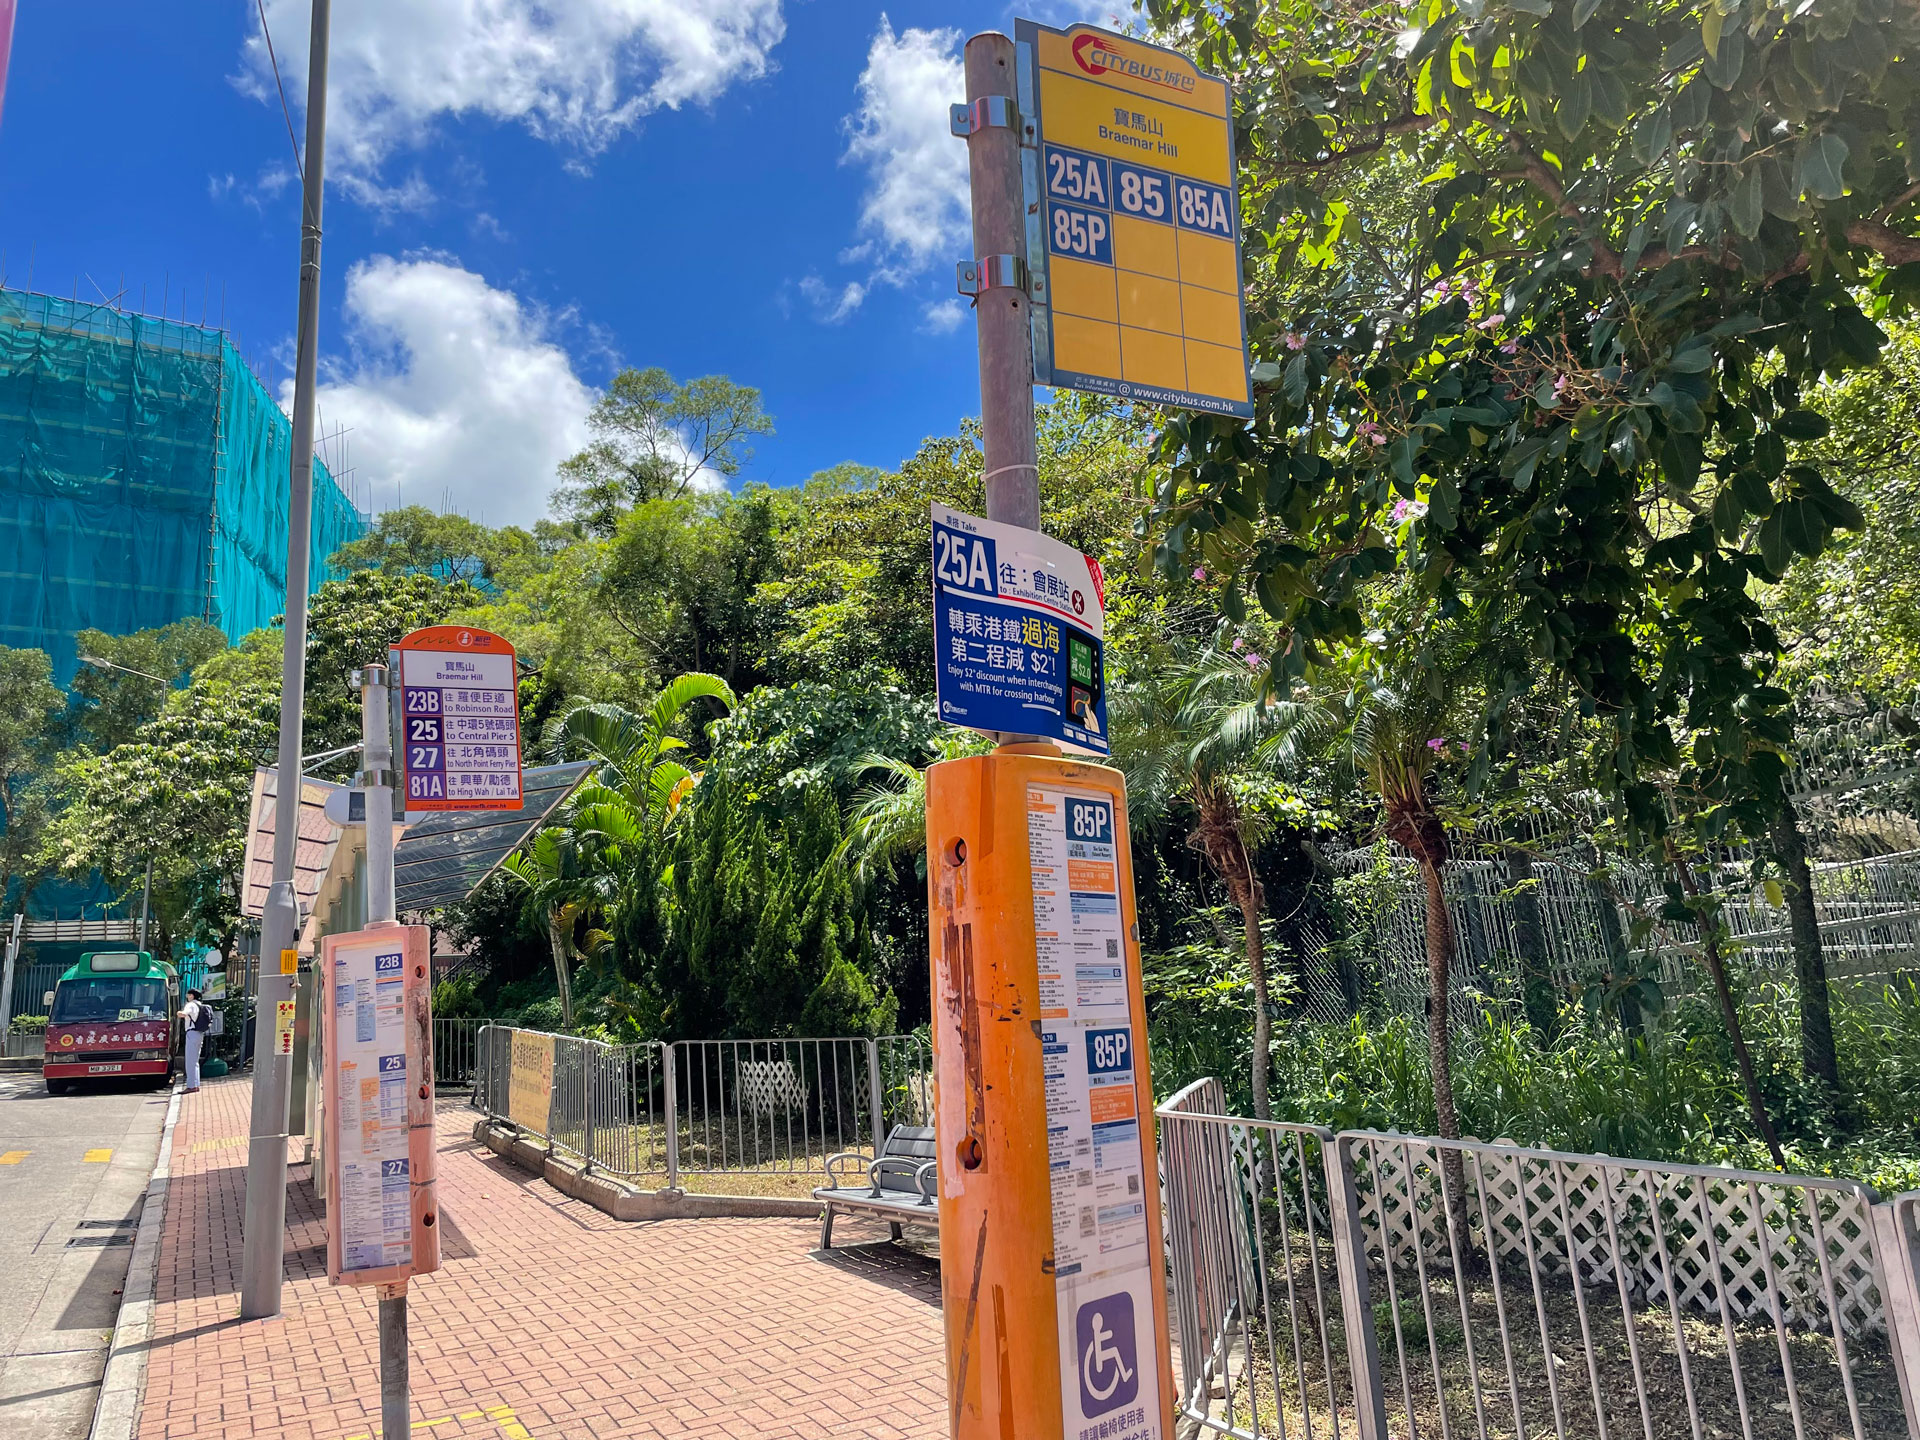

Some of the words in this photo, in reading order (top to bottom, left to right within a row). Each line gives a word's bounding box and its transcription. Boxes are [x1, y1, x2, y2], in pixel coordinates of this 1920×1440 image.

[1091, 50, 1163, 81] CITYBUS
[1165, 70, 1195, 91] 城巴
[1114, 108, 1163, 137] 寶馬山
[1099, 125, 1153, 151] Braemar
[1158, 142, 1178, 158] Hill
[1050, 153, 1106, 203] 25A
[1121, 171, 1164, 217] 85
[1179, 185, 1230, 233] 85A
[1054, 208, 1106, 255] 85P
[1134, 388, 1234, 413] www.citybus.com.hk
[961, 521, 977, 533] Take
[936, 530, 993, 592] 25A
[1013, 588, 1042, 601] Exhibition
[1044, 595, 1058, 607] Centre
[1060, 601, 1073, 613] Station
[949, 608, 1060, 654] 轉乘港鐵過海
[951, 636, 1025, 672] 第二程減
[436, 672, 468, 681] Braemar
[471, 673, 483, 681] Hill
[445, 661, 475, 672] 寶馬山
[948, 664, 963, 678] Enjoy
[976, 671, 1005, 683] discount
[1007, 676, 1026, 686] when
[1028, 677, 1063, 697] interchanging
[408, 691, 439, 712] 23B
[458, 691, 505, 703] 羅便臣道
[960, 681, 974, 692] with
[975, 684, 991, 695] MTR
[992, 686, 1002, 696] for
[1004, 689, 1033, 702] crossing
[1034, 692, 1055, 704] harbour
[455, 704, 491, 713] Robinson
[494, 705, 513, 713] Road
[411, 719, 438, 741] 25
[457, 718, 515, 731] 中環5號碼頭
[446, 732, 455, 740] to
[458, 732, 489, 740] Central
[491, 732, 507, 740] Pier
[412, 747, 438, 769] 27
[461, 746, 508, 758] 北角碼頭
[455, 760, 472, 768] North
[474, 760, 488, 768] Point
[490, 760, 504, 769] Ferry
[411, 775, 443, 797] 81A
[448, 788, 455, 796] to
[457, 788, 473, 798] Hing
[475, 788, 490, 796] Wah
[496, 788, 505, 796] Lai
[507, 788, 518, 796] Tak
[1073, 804, 1107, 838] 85P
[380, 956, 399, 969] 23B
[1094, 1033, 1127, 1068] 85P
[385, 1057, 401, 1070] 25
[389, 1161, 403, 1175] 27
